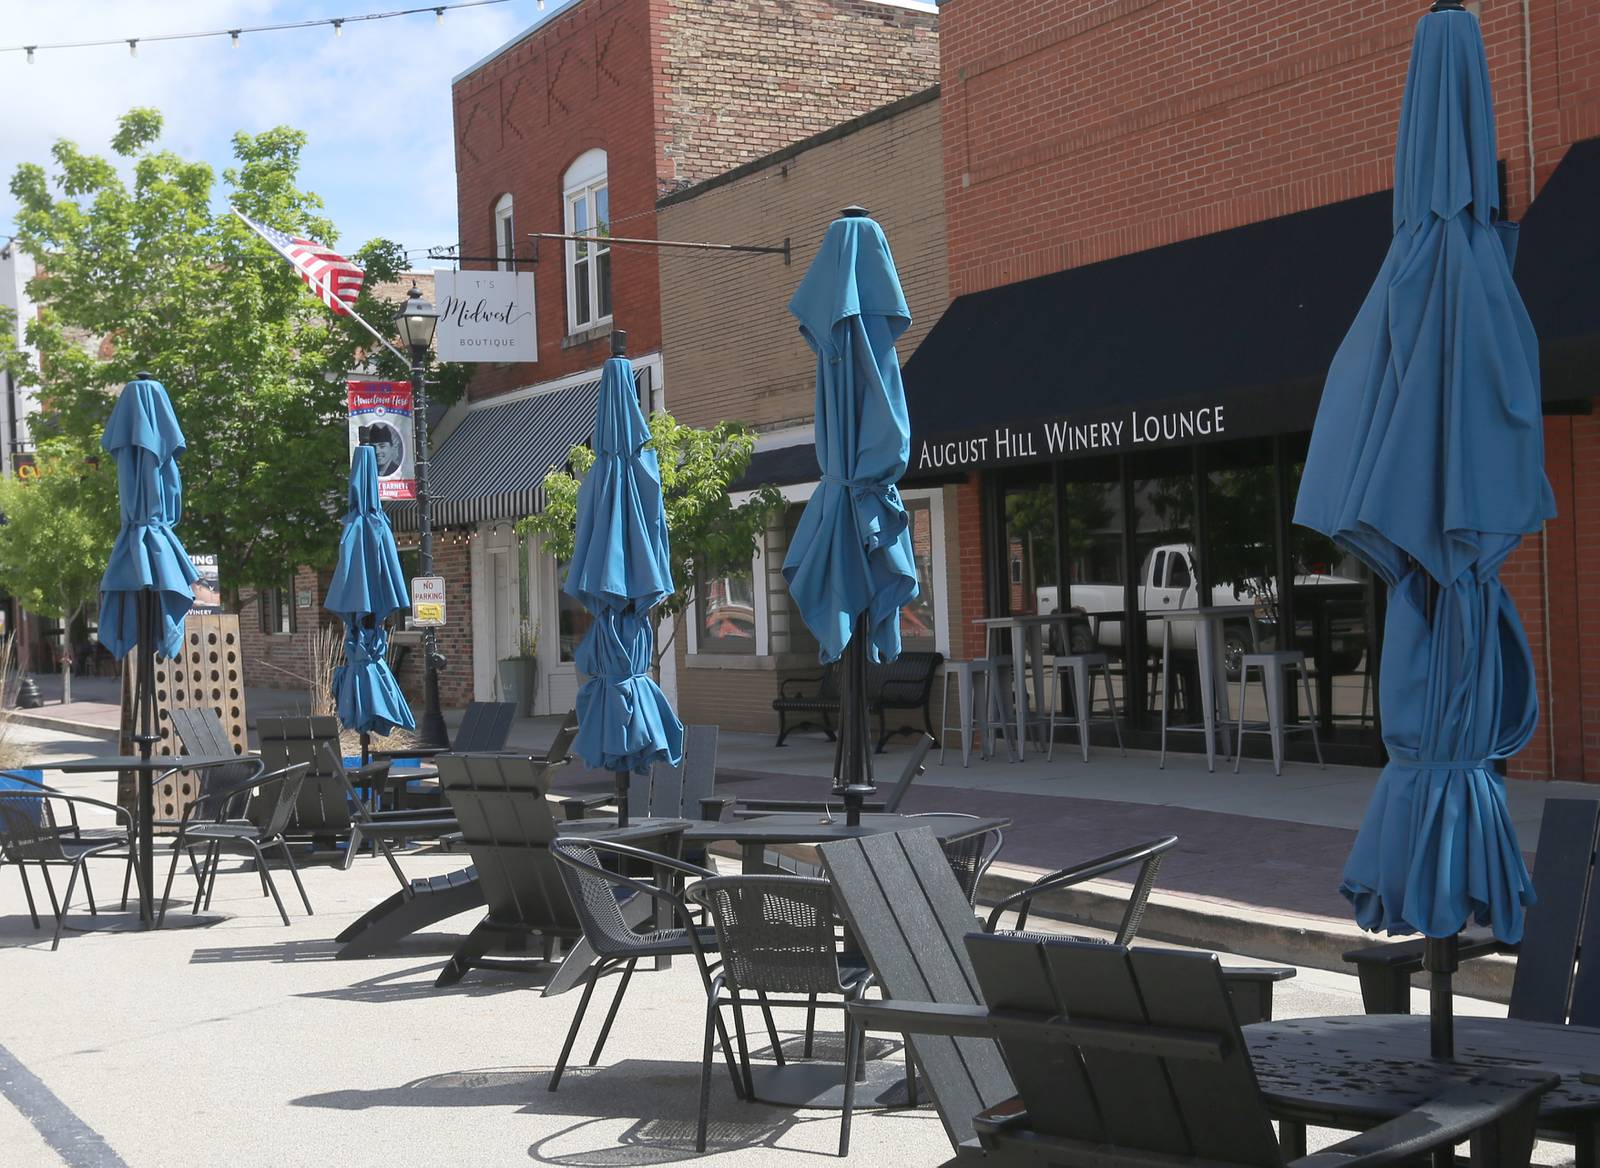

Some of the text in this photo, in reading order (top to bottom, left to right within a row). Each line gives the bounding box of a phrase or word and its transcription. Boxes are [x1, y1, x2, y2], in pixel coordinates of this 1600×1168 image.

[441, 295, 532, 328] Midwest
[459, 339, 516, 347] BOUTIQUE
[918, 405, 1225, 470] AUGUST HILL WINERY LOUNGE
[423, 581, 434, 590] NO
[415, 592, 443, 600] PARKING
